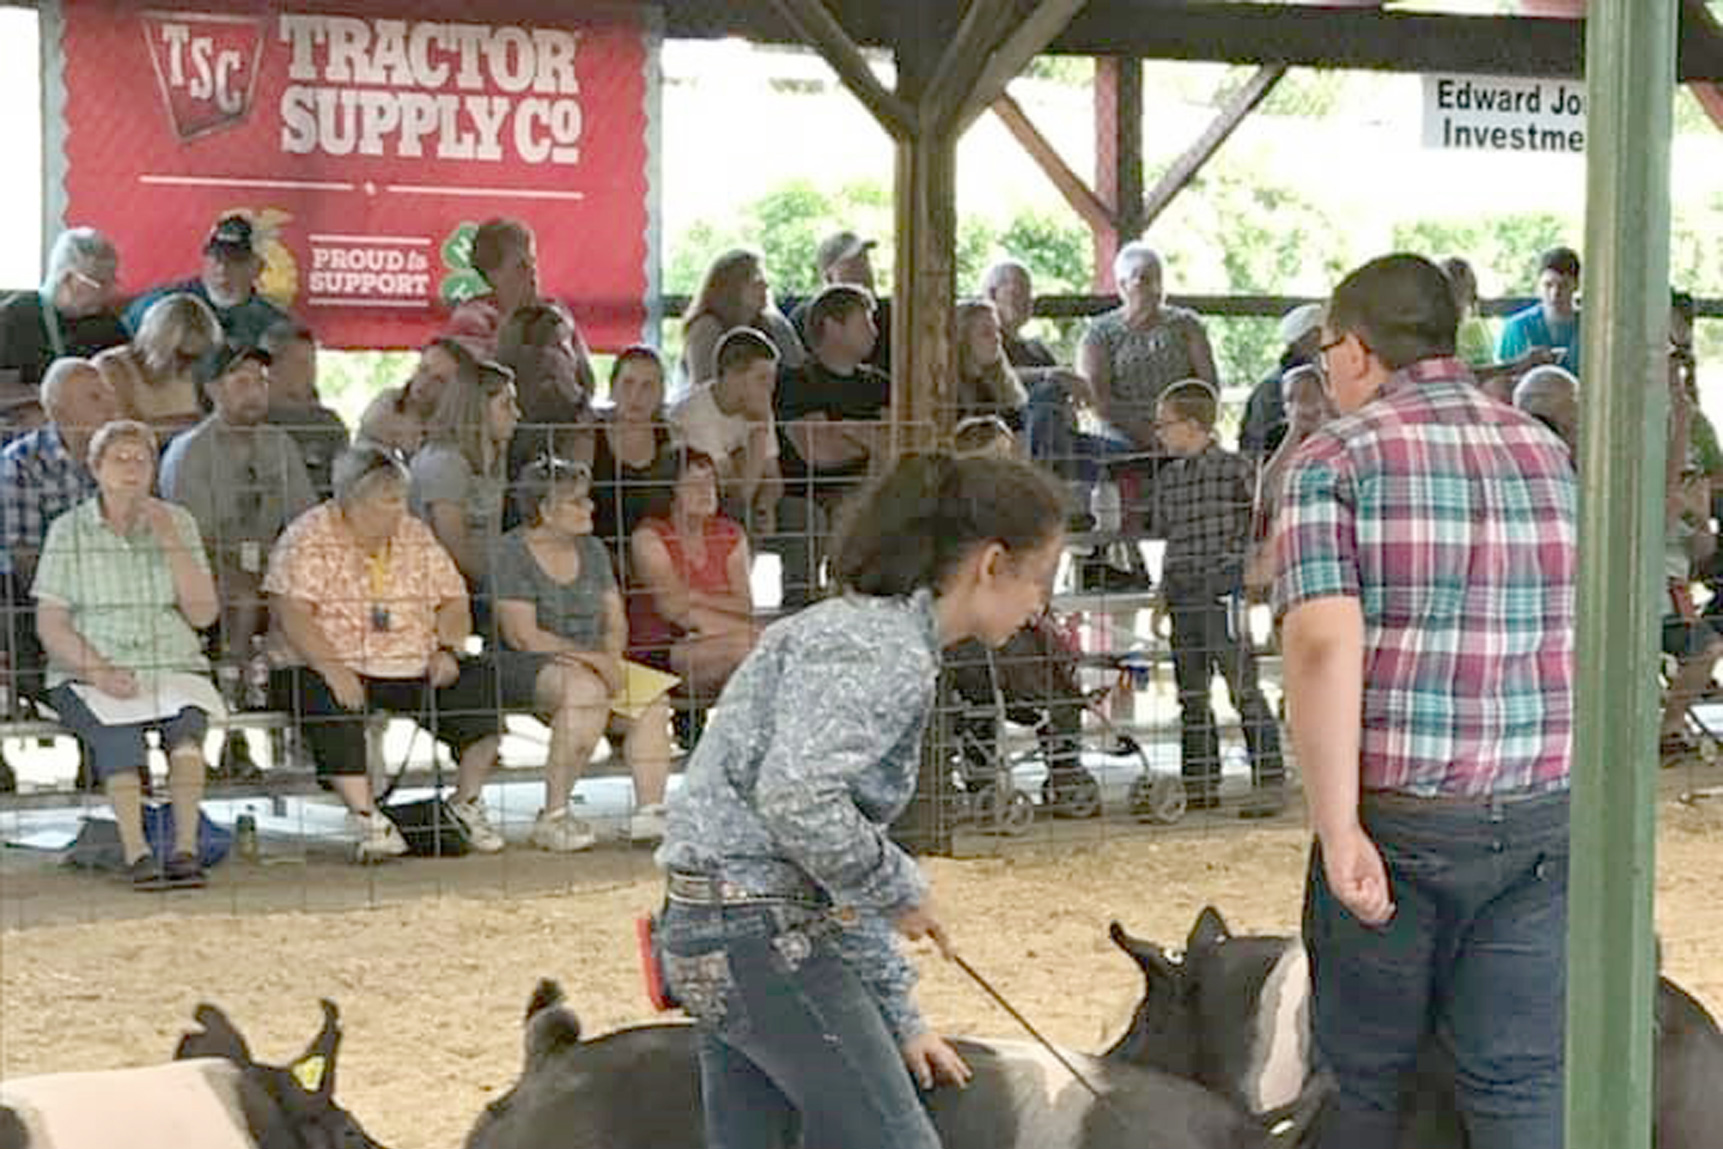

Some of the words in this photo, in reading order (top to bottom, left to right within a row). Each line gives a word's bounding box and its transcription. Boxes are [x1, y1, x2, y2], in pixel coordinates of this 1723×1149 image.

[161, 23, 242, 115] TSC
[279, 13, 579, 94] TRACTOR
[1437, 78, 1541, 114] Edward
[1550, 85, 1588, 117] Jo
[280, 84, 510, 161] SUPPLY
[1444, 116, 1586, 152] Investme
[312, 248, 405, 271] PROUD
[308, 271, 431, 296] SUPPORT
